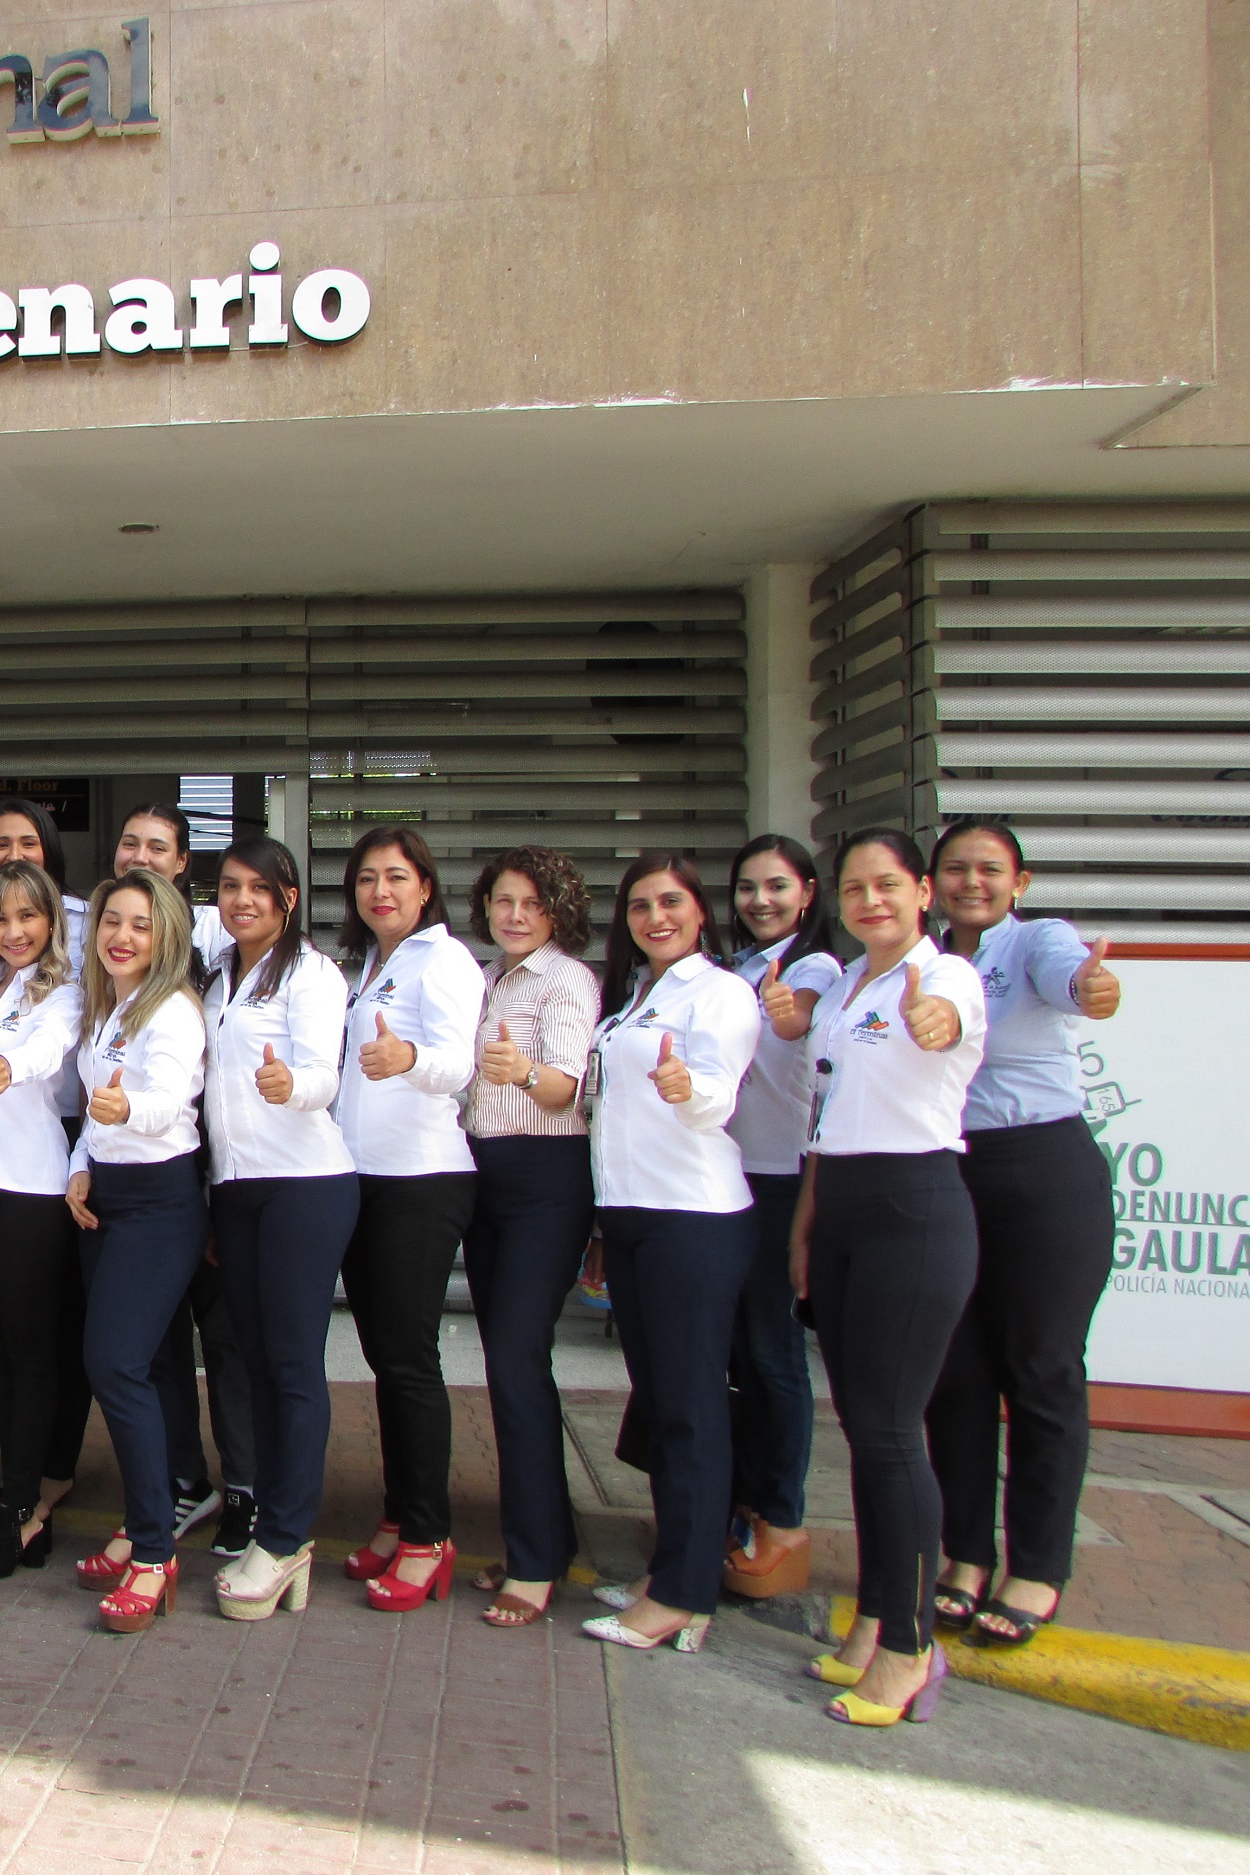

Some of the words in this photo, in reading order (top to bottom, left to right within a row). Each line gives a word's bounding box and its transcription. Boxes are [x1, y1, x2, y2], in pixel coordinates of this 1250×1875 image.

[16, 779, 58, 792] Floor
[1099, 1141, 1163, 1187] YO
[1112, 1190, 1249, 1227] DENUNC
[1112, 1227, 1250, 1276] GAULA
